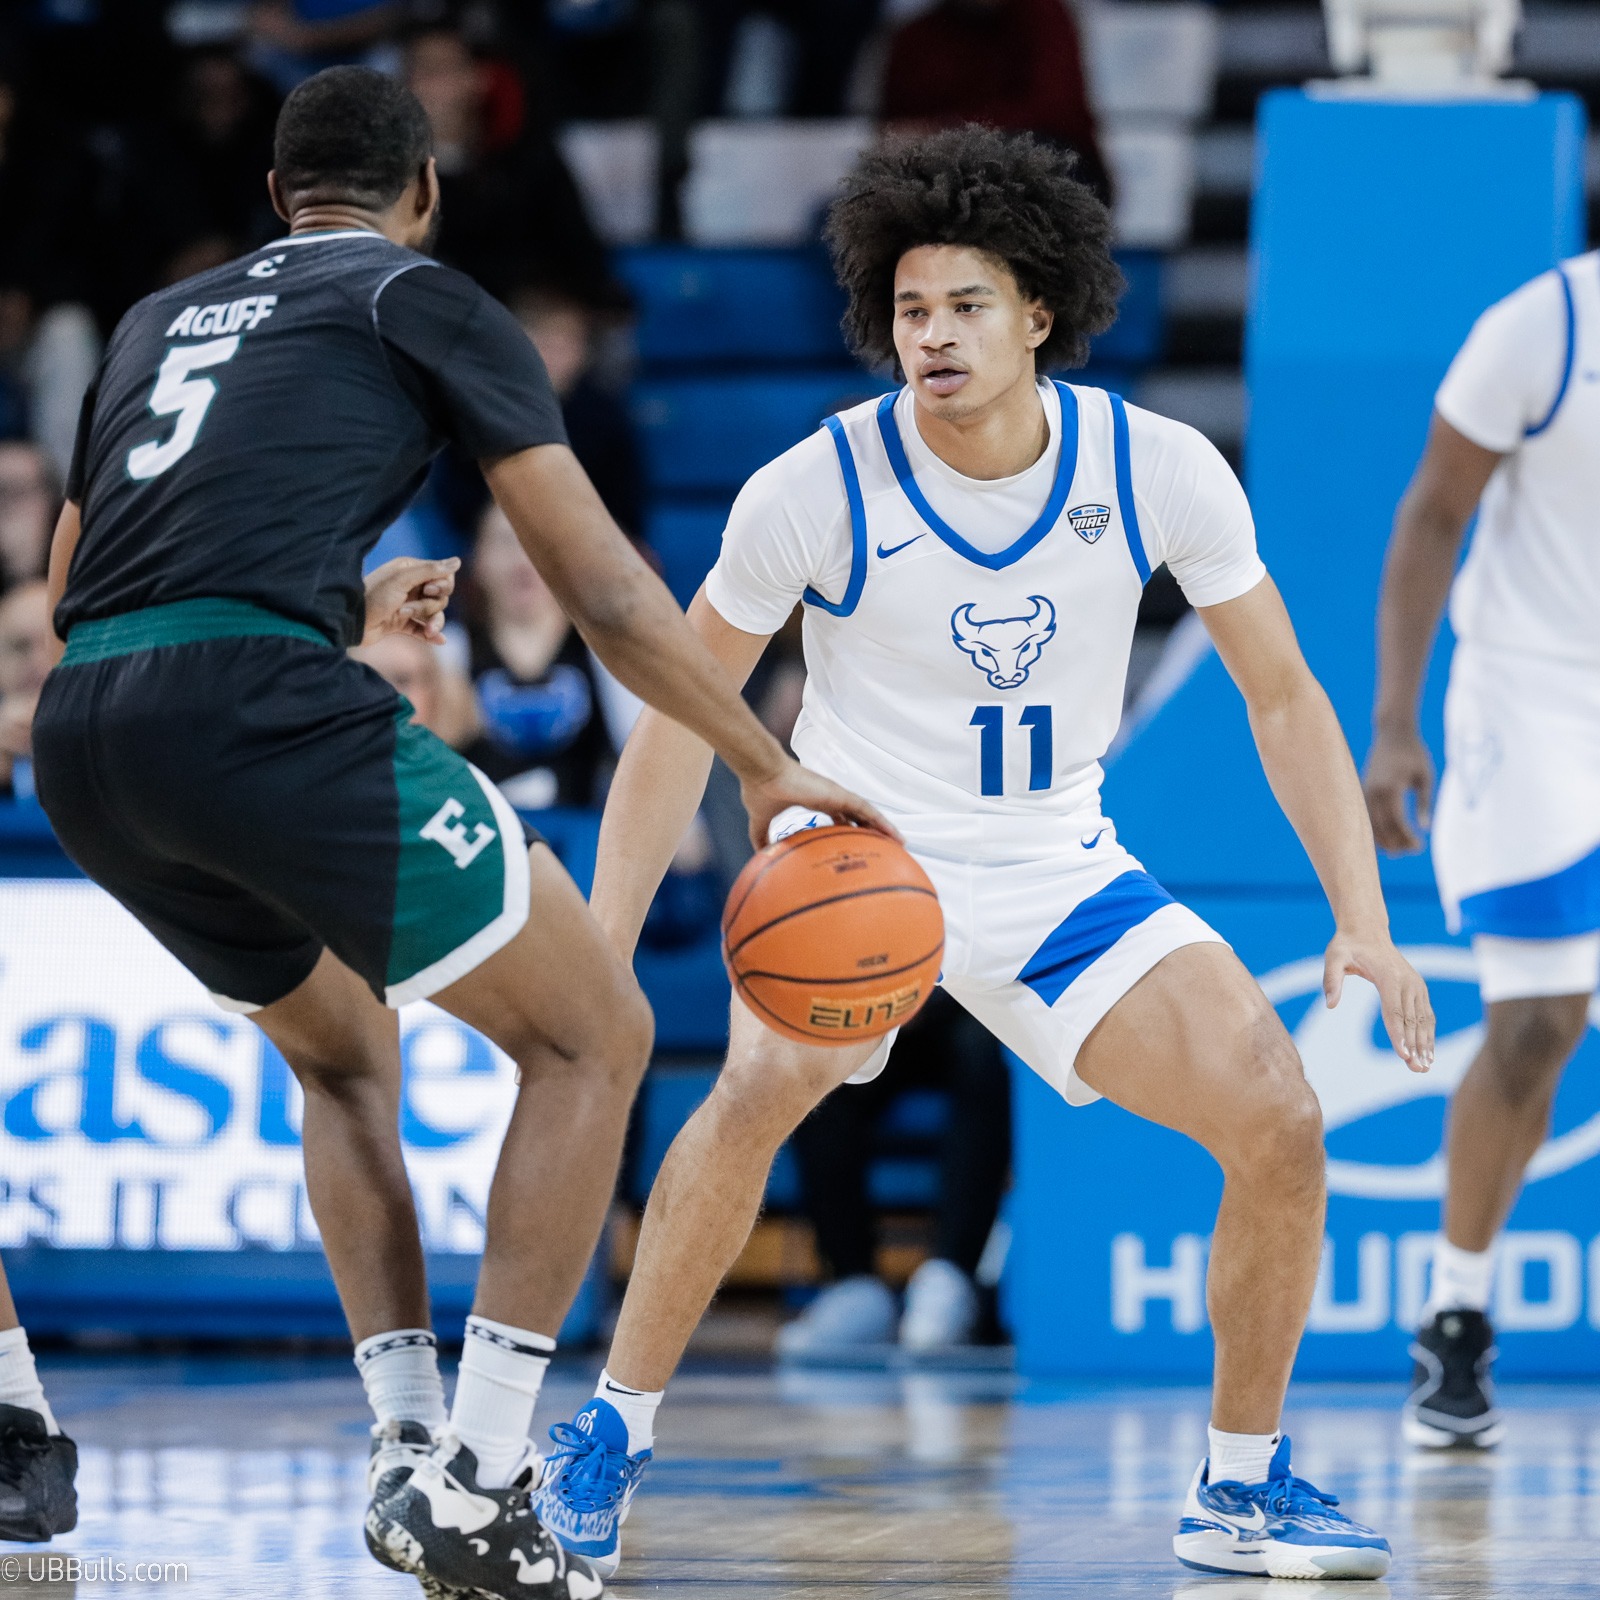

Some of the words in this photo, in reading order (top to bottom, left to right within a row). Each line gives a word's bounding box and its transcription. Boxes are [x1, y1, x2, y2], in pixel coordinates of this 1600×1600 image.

[165, 294, 278, 337] AGUFF
[125, 334, 243, 482] 5
[1071, 514, 1109, 530] MAC
[969, 705, 1053, 796] 11
[418, 797, 497, 870] E
